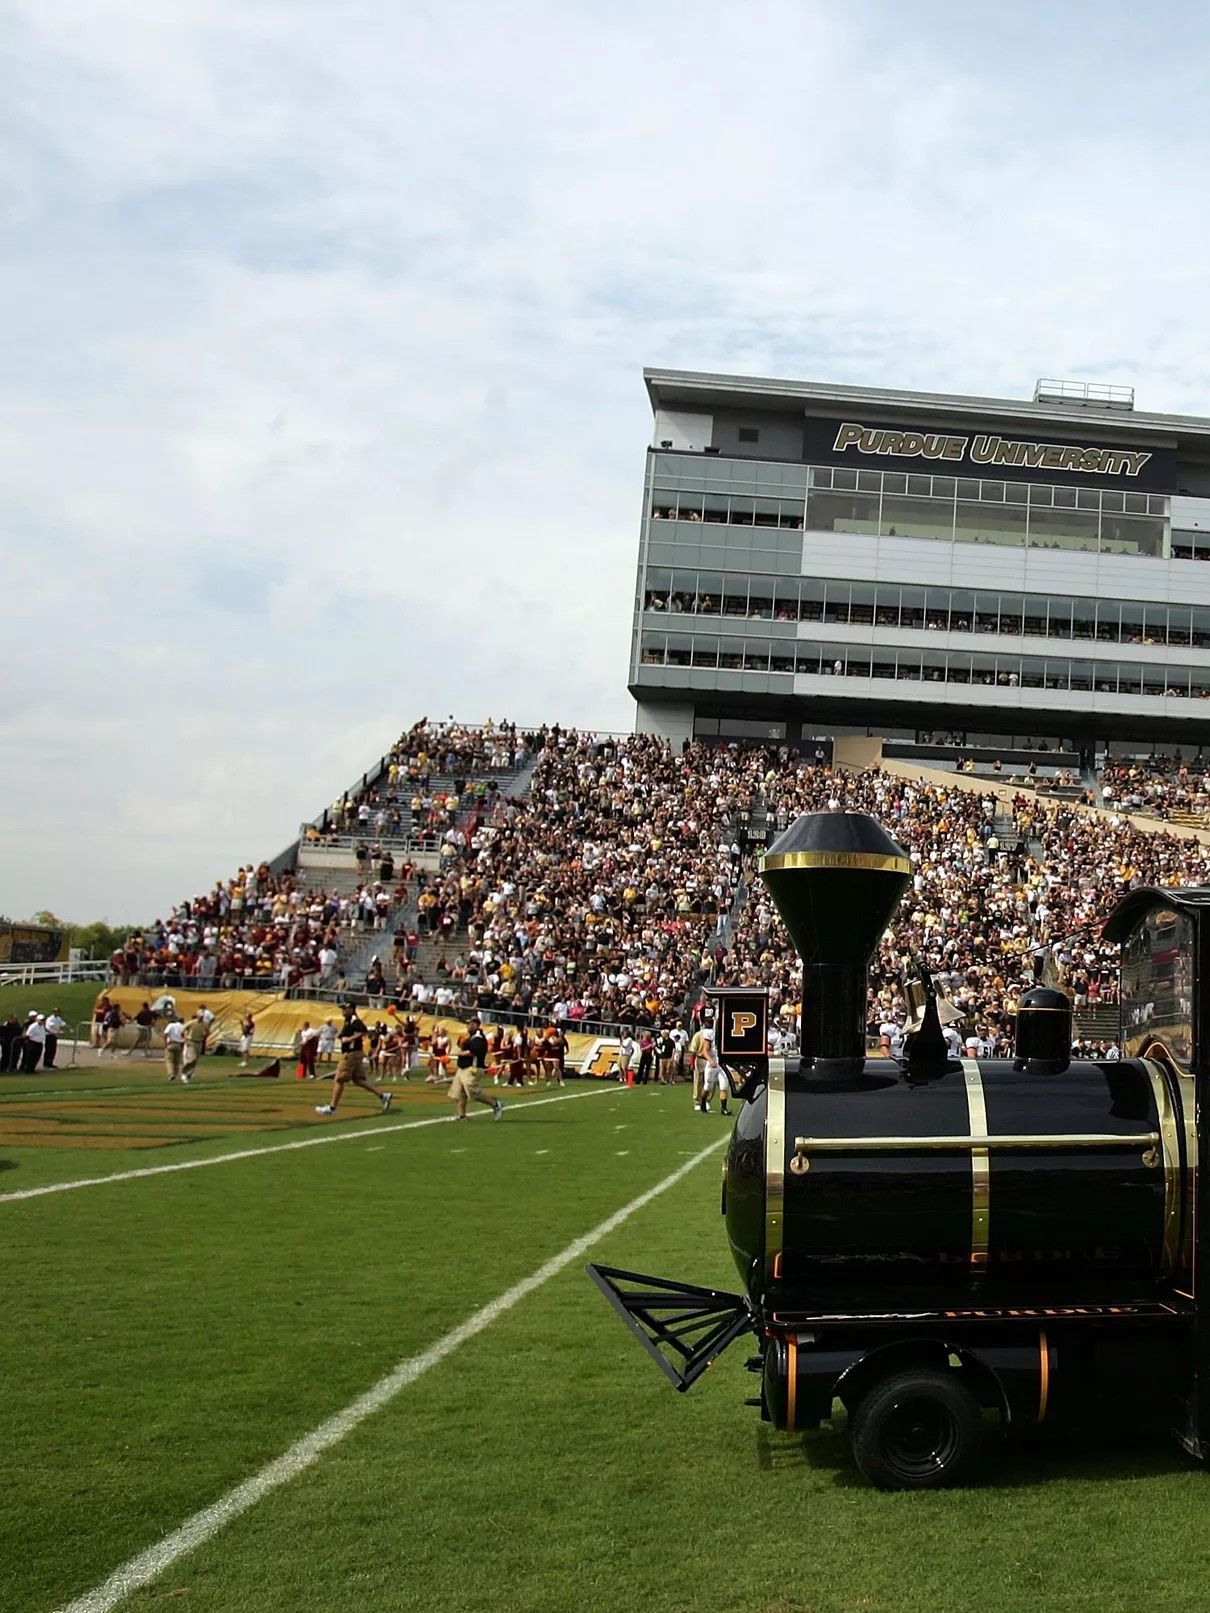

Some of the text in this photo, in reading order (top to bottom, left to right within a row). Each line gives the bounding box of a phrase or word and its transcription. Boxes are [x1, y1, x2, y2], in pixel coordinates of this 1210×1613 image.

[833, 423, 1152, 476] PURDUE UNIVERSITY
[731, 1012, 757, 1037] P
